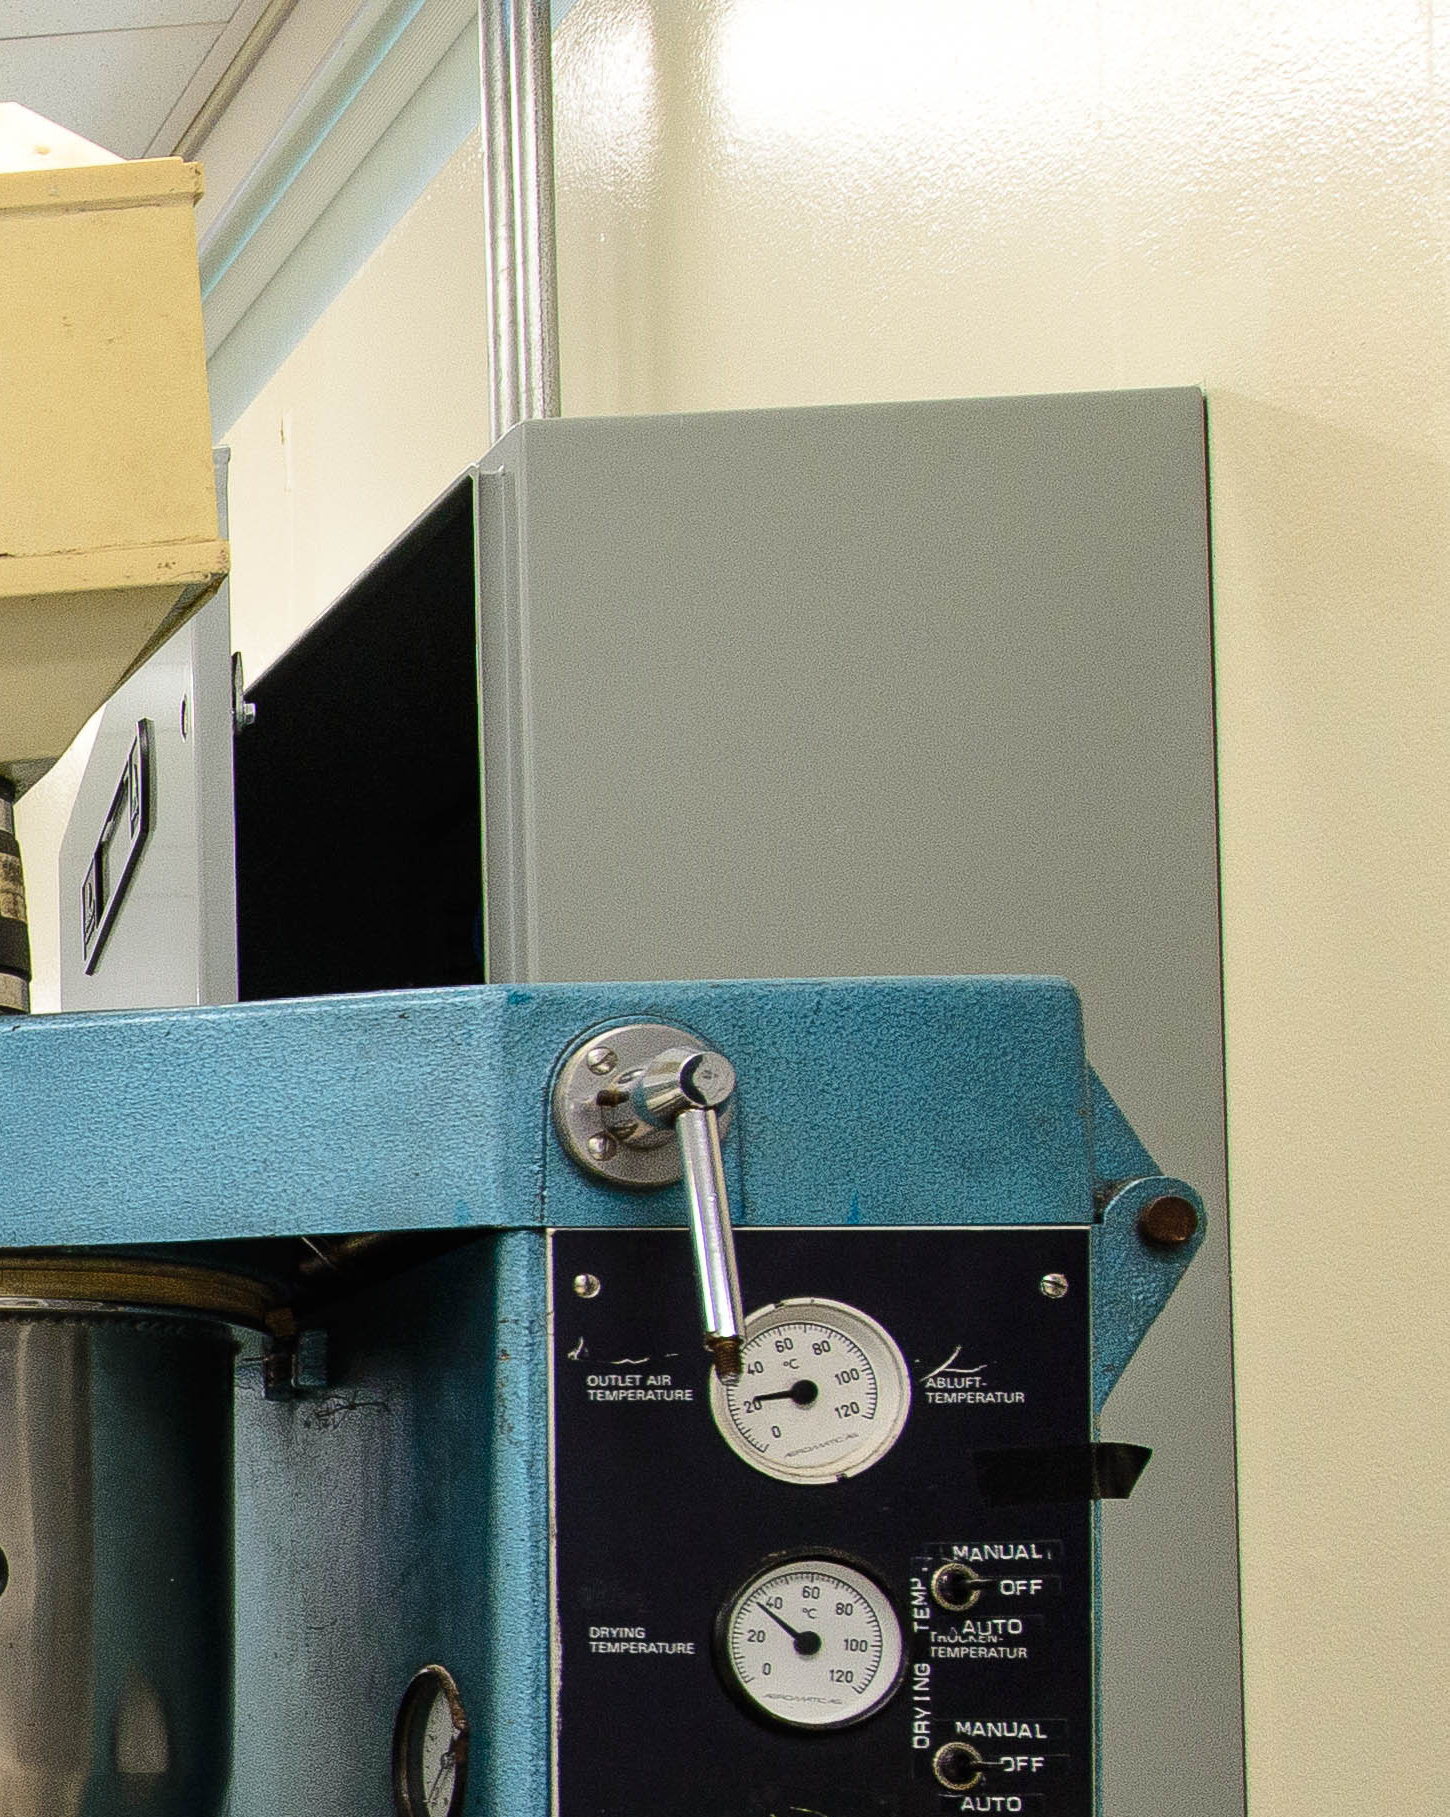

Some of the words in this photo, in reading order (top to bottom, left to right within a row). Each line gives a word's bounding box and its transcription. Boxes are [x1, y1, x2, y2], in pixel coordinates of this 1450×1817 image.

[774, 1337, 794, 1353] 60
[812, 1339, 832, 1356] 80
[746, 1360, 765, 1376] 40
[587, 1374, 644, 1387] OUTLET
[646, 1374, 672, 1387] AIR
[834, 1367, 860, 1385] 100
[925, 1376, 988, 1391] ABLUFT-
[587, 1388, 694, 1402] TEMPERATURE
[925, 1391, 1025, 1405] TEMPERATUR
[743, 1399, 763, 1414] 20
[834, 1401, 860, 1419] 120
[770, 1425, 782, 1439] 0
[953, 1545, 1043, 1563] MANUAL
[802, 1586, 821, 1599] 60
[1000, 1579, 1043, 1596] OFF
[765, 1597, 783, 1610] 40
[835, 1602, 853, 1616] 80
[589, 1627, 647, 1641] DRYING
[963, 1618, 1023, 1635] AUTO
[747, 1629, 766, 1643] 20
[589, 1641, 696, 1656] TEMPERATURE
[843, 1639, 868, 1652] 100
[931, 1646, 1028, 1659] TEMPERATUR
[762, 1663, 772, 1676] 0
[829, 1669, 854, 1683] 120
[912, 1662, 932, 1750] DRYING
[955, 1720, 1048, 1739] MANUAL
[1001, 1756, 1045, 1773] OFF
[961, 1795, 1023, 1812] AUTO
